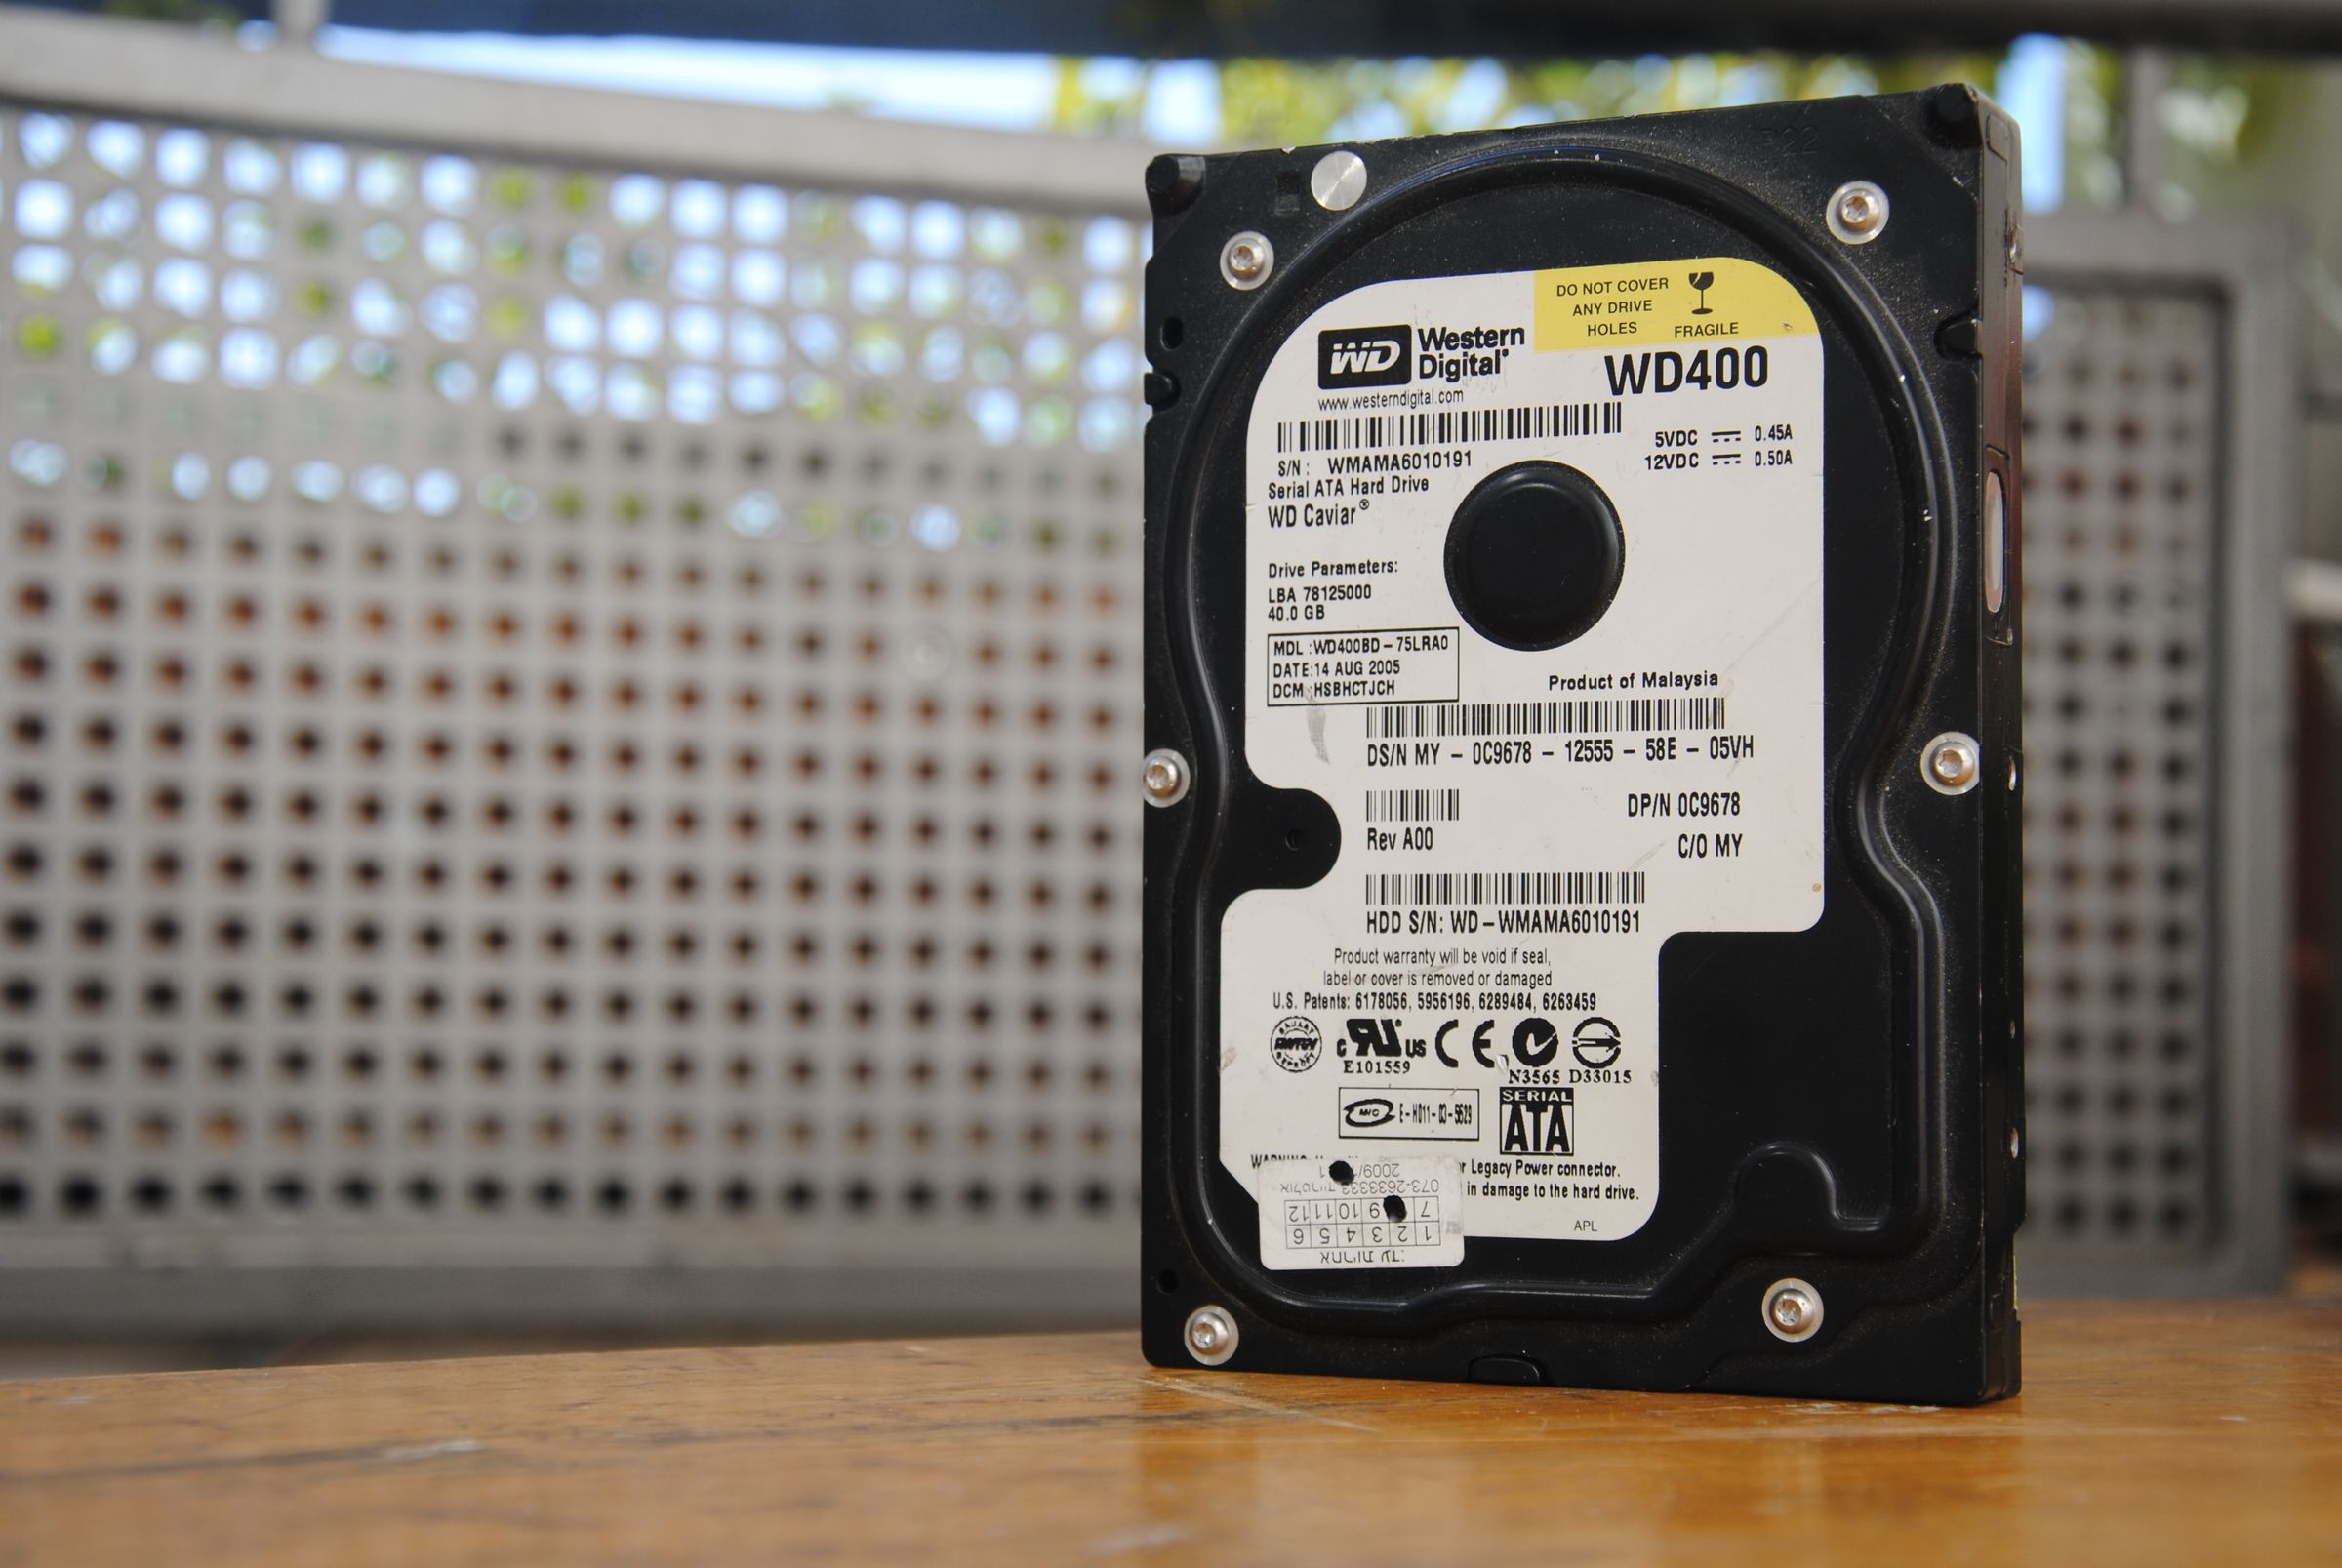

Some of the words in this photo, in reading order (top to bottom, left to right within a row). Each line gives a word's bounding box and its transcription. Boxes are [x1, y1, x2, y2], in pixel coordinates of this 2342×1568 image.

[1557, 284, 1577, 297] DO
[1583, 282, 1612, 295] NOT
[1618, 277, 1669, 293] COVER
[1573, 303, 1602, 316] ANY
[1608, 301, 1652, 314] DRIVE
[1588, 322, 1637, 336] HOLES
[1675, 322, 1739, 338] FRAGILE
[1418, 327, 1524, 351] Western
[1331, 341, 1400, 374] WD
[1604, 345, 1767, 396] WD400
[1318, 390, 1464, 411] www.westerndigital.com
[1655, 430, 1698, 448] 5VDC
[1755, 424, 1793, 441] 0.45A
[1328, 450, 1472, 474] WMAMA6010191
[1645, 452, 1699, 470] 12VDC
[1755, 450, 1793, 466] 0.50A
[1269, 481, 1309, 499] Serial
[1315, 479, 1343, 497] ATA
[1351, 476, 1384, 495] Hard
[1392, 475, 1429, 493] Drive
[1269, 505, 1296, 528] WD
[1269, 563, 1304, 578] Drive
[1312, 559, 1397, 577] Parameters:
[1269, 588, 1296, 603] LBA
[1304, 584, 1371, 602] 78125000
[1269, 606, 1297, 621] 40.0
[1304, 605, 1325, 619] GB
[1335, 662, 1363, 676] AUG
[1369, 660, 1400, 674] 2005
[1550, 674, 1613, 691] Product
[1620, 673, 1635, 688] of
[1642, 670, 1718, 691] Malaysia
[1367, 744, 1406, 767] DS/N
[1415, 743, 1440, 765] MY
[1565, 739, 1613, 762] 12555
[1646, 737, 1676, 761] 58E
[1710, 735, 1754, 759] 05VH
[1629, 793, 1670, 818] DP/N
[1367, 828, 1396, 850] Rev
[1403, 827, 1433, 850] A00
[1716, 833, 1743, 857] MY
[1367, 910, 1401, 934] HDD
[1409, 910, 1443, 934] S/N:
[1335, 948, 1379, 964] Product
[1383, 948, 1435, 966] warranty
[1440, 948, 1458, 964] will
[1464, 948, 1477, 964] be
[1482, 948, 1506, 964] void
[1512, 948, 1517, 963] if
[1522, 948, 1551, 965] seal,
[1324, 971, 1351, 985] label
[1354, 974, 1366, 985] or
[1371, 974, 1403, 986] cover
[1408, 971, 1417, 985] is
[1422, 971, 1474, 985] removed
[1478, 973, 1489, 985] or
[1495, 971, 1552, 989] damaged
[1273, 993, 1297, 1009] U.S.
[1304, 992, 1350, 1009] Patents:
[1355, 992, 1412, 1012] 6178056,
[1418, 993, 1474, 1012] 5956196,
[1479, 993, 1536, 1013] 6289484,
[1543, 993, 1596, 1011] 6263459
[1435, 1019, 1495, 1067] CE
[1344, 1061, 1410, 1073] E101559
[1509, 1070, 1560, 1084] N3565
[1569, 1070, 1632, 1083] D33015
[1503, 1091, 1572, 1101] SERIAL
[1505, 1102, 1570, 1152] ATA
[1472, 1159, 1512, 1178] Legacy
[1516, 1160, 1553, 1176] Power
[1557, 1162, 1620, 1177] connector.
[1468, 1182, 1476, 1195] in
[1483, 1182, 1529, 1200] damage
[1534, 1184, 1545, 1197] to
[1550, 1183, 1567, 1198] the
[1573, 1183, 1600, 1199] hard
[1605, 1185, 1638, 1200] drive.
[1289, 1205, 1310, 1222] 12
[1315, 1203, 1334, 1219] 11
[1340, 1203, 1359, 1219] 10
[1422, 1202, 1429, 1218] 7
[1347, 1227, 1355, 1241] 4
[1372, 1227, 1382, 1242] 3
[1397, 1226, 1407, 1242] 2
[1425, 1226, 1431, 1241] 1
[1574, 1221, 1597, 1231] APL
[1293, 1228, 1304, 1245] 6
[1320, 1228, 1329, 1244] 5
[1320, 1251, 1372, 1263] אחריות
